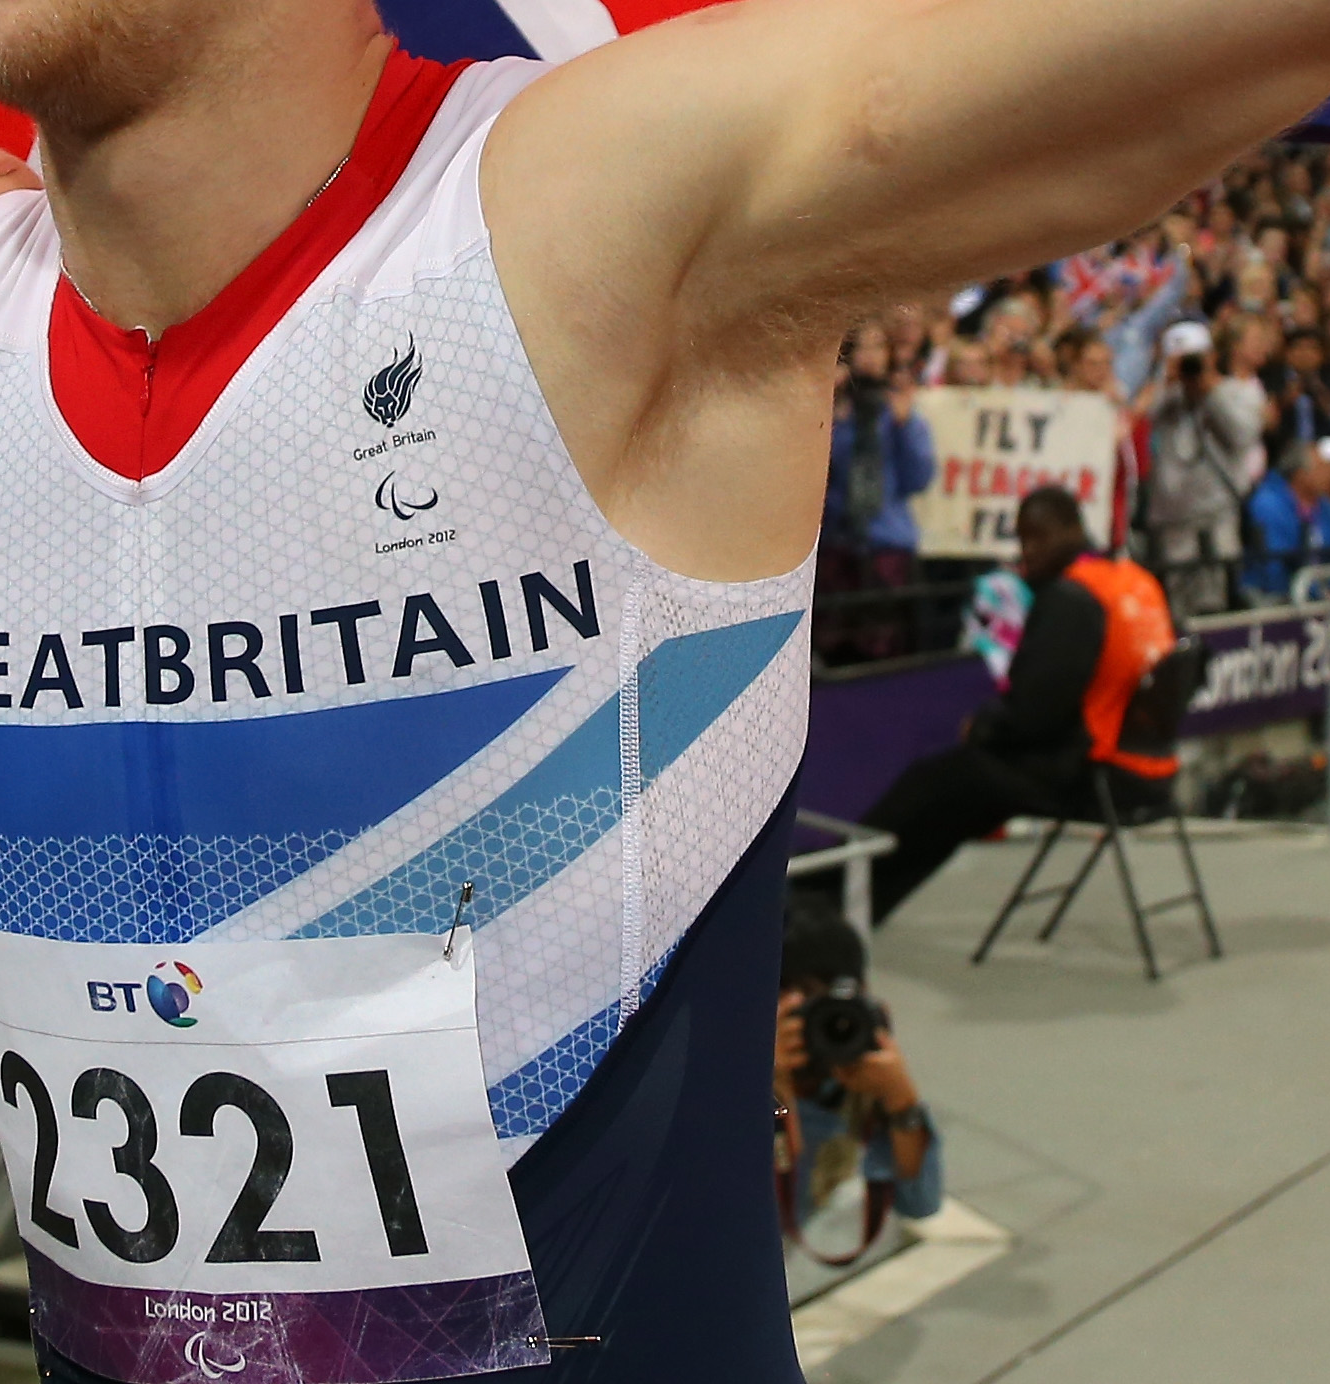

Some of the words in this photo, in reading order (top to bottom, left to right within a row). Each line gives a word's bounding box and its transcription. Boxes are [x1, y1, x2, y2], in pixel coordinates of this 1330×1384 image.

[353, 440, 389, 461] Great
[392, 429, 437, 448] Britain
[975, 409, 1050, 452] FLY
[971, 508, 1018, 542] FL
[375, 537, 423, 554] London
[428, 529, 456, 544] 2012
[87, 981, 142, 1013] BT
[0, 1050, 429, 1264] 2321
[145, 1296, 216, 1322] London
[222, 1301, 271, 1322] 2012
